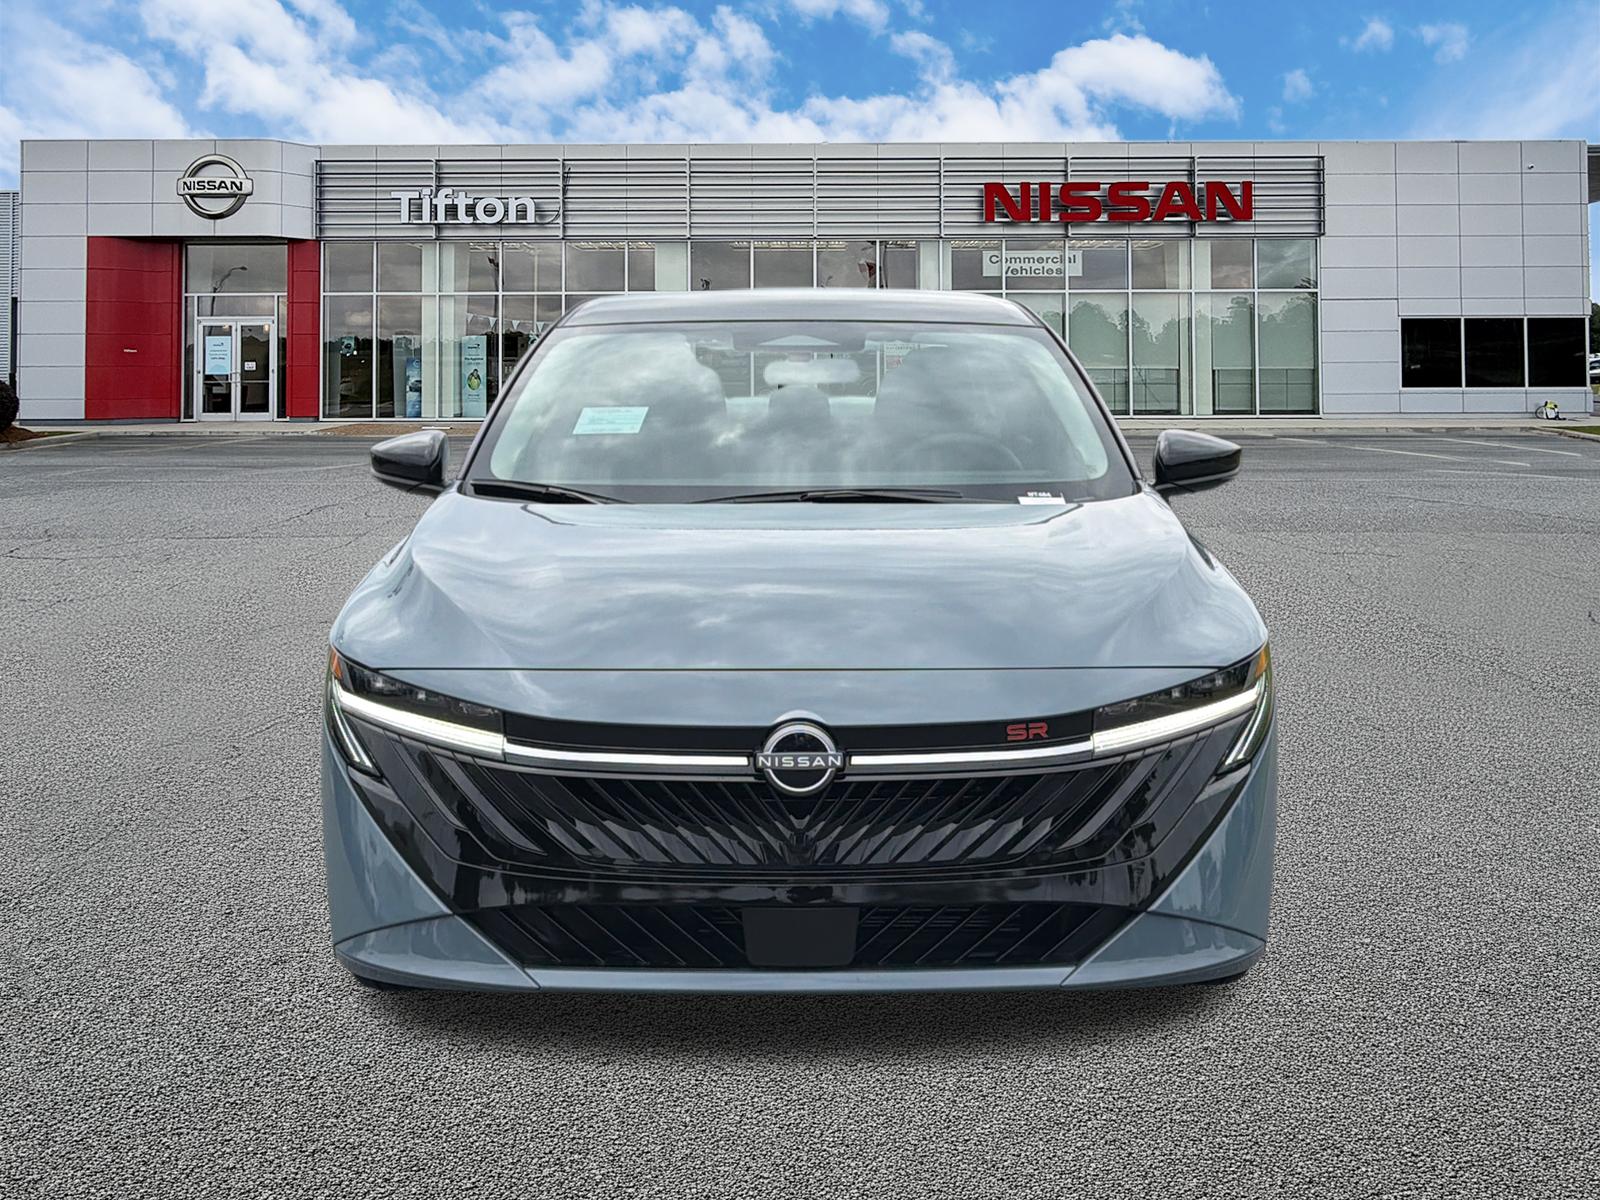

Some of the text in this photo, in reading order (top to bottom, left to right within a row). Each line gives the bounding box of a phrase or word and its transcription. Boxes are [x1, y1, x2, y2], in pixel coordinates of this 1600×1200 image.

[182, 180, 244, 191] NISSAN
[390, 187, 536, 225] Tifton
[983, 180, 1254, 222] NISSAN
[988, 254, 1077, 264] Commercial
[1004, 266, 1063, 276] Vehicles
[1006, 722, 1049, 741] SR
[758, 755, 841, 767] NISSAN
